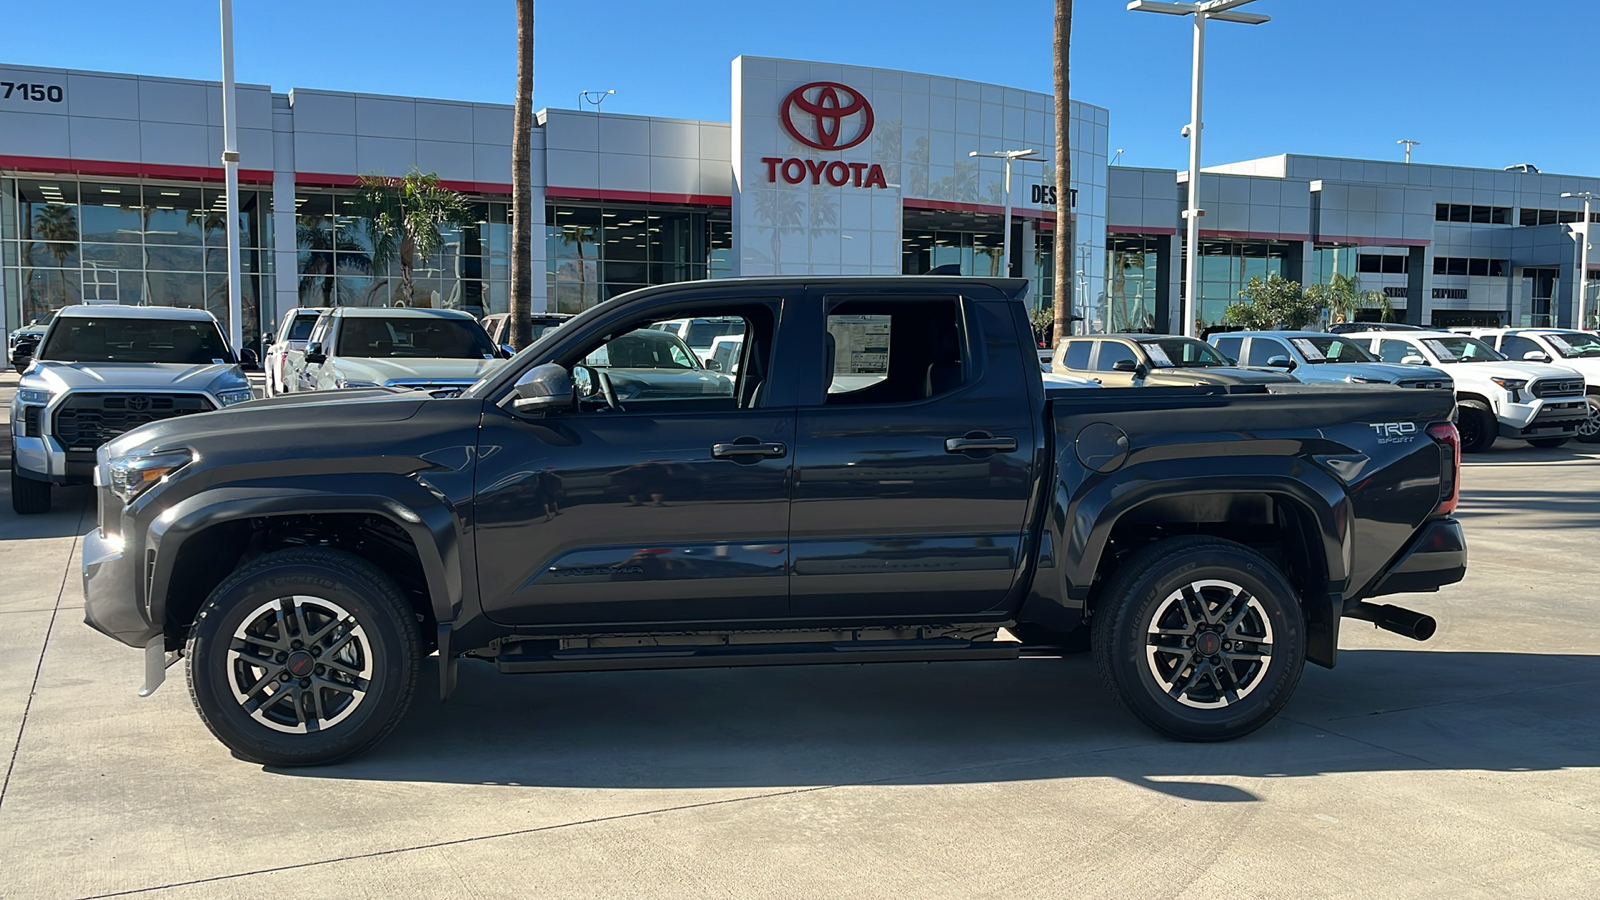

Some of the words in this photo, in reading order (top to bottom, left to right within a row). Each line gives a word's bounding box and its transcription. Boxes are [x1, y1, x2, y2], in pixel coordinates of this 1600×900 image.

[0, 81, 63, 103] 7150
[761, 157, 888, 189] TOYOTA
[1031, 184, 1078, 208] DEST
[1369, 422, 1416, 436] TRD
[1377, 436, 1414, 444] SPORT
